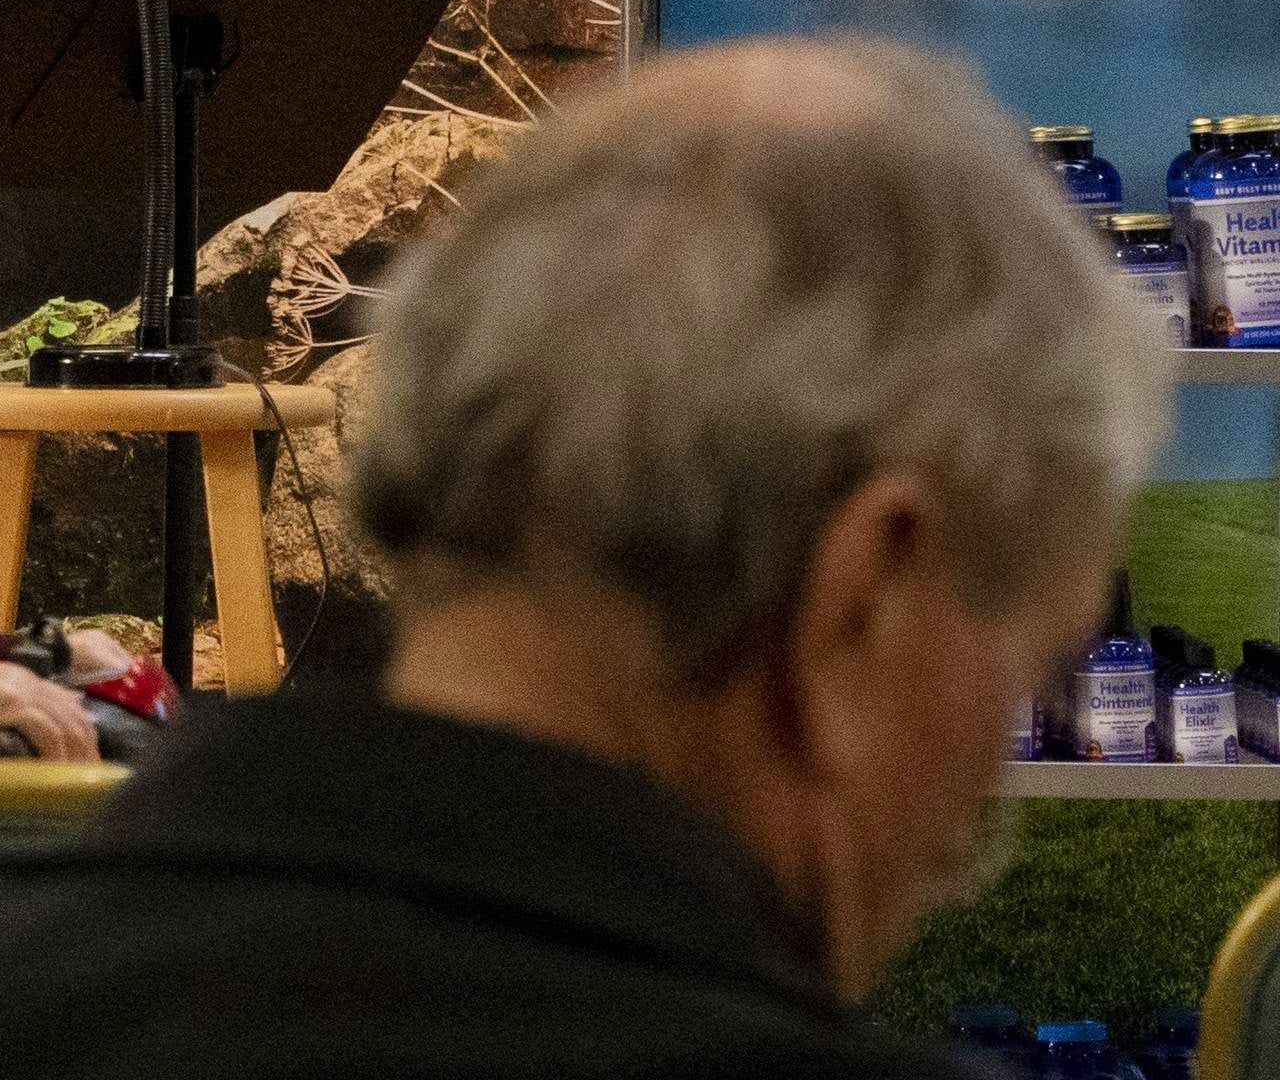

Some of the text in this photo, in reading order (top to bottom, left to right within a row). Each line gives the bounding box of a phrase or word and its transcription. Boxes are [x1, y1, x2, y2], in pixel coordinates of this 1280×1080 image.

[1226, 206, 1280, 232] Heal
[1100, 681, 1146, 695] Health
[1090, 696, 1153, 710] Ointment
[1180, 701, 1220, 714] Health
[1185, 715, 1217, 728] Elixir
